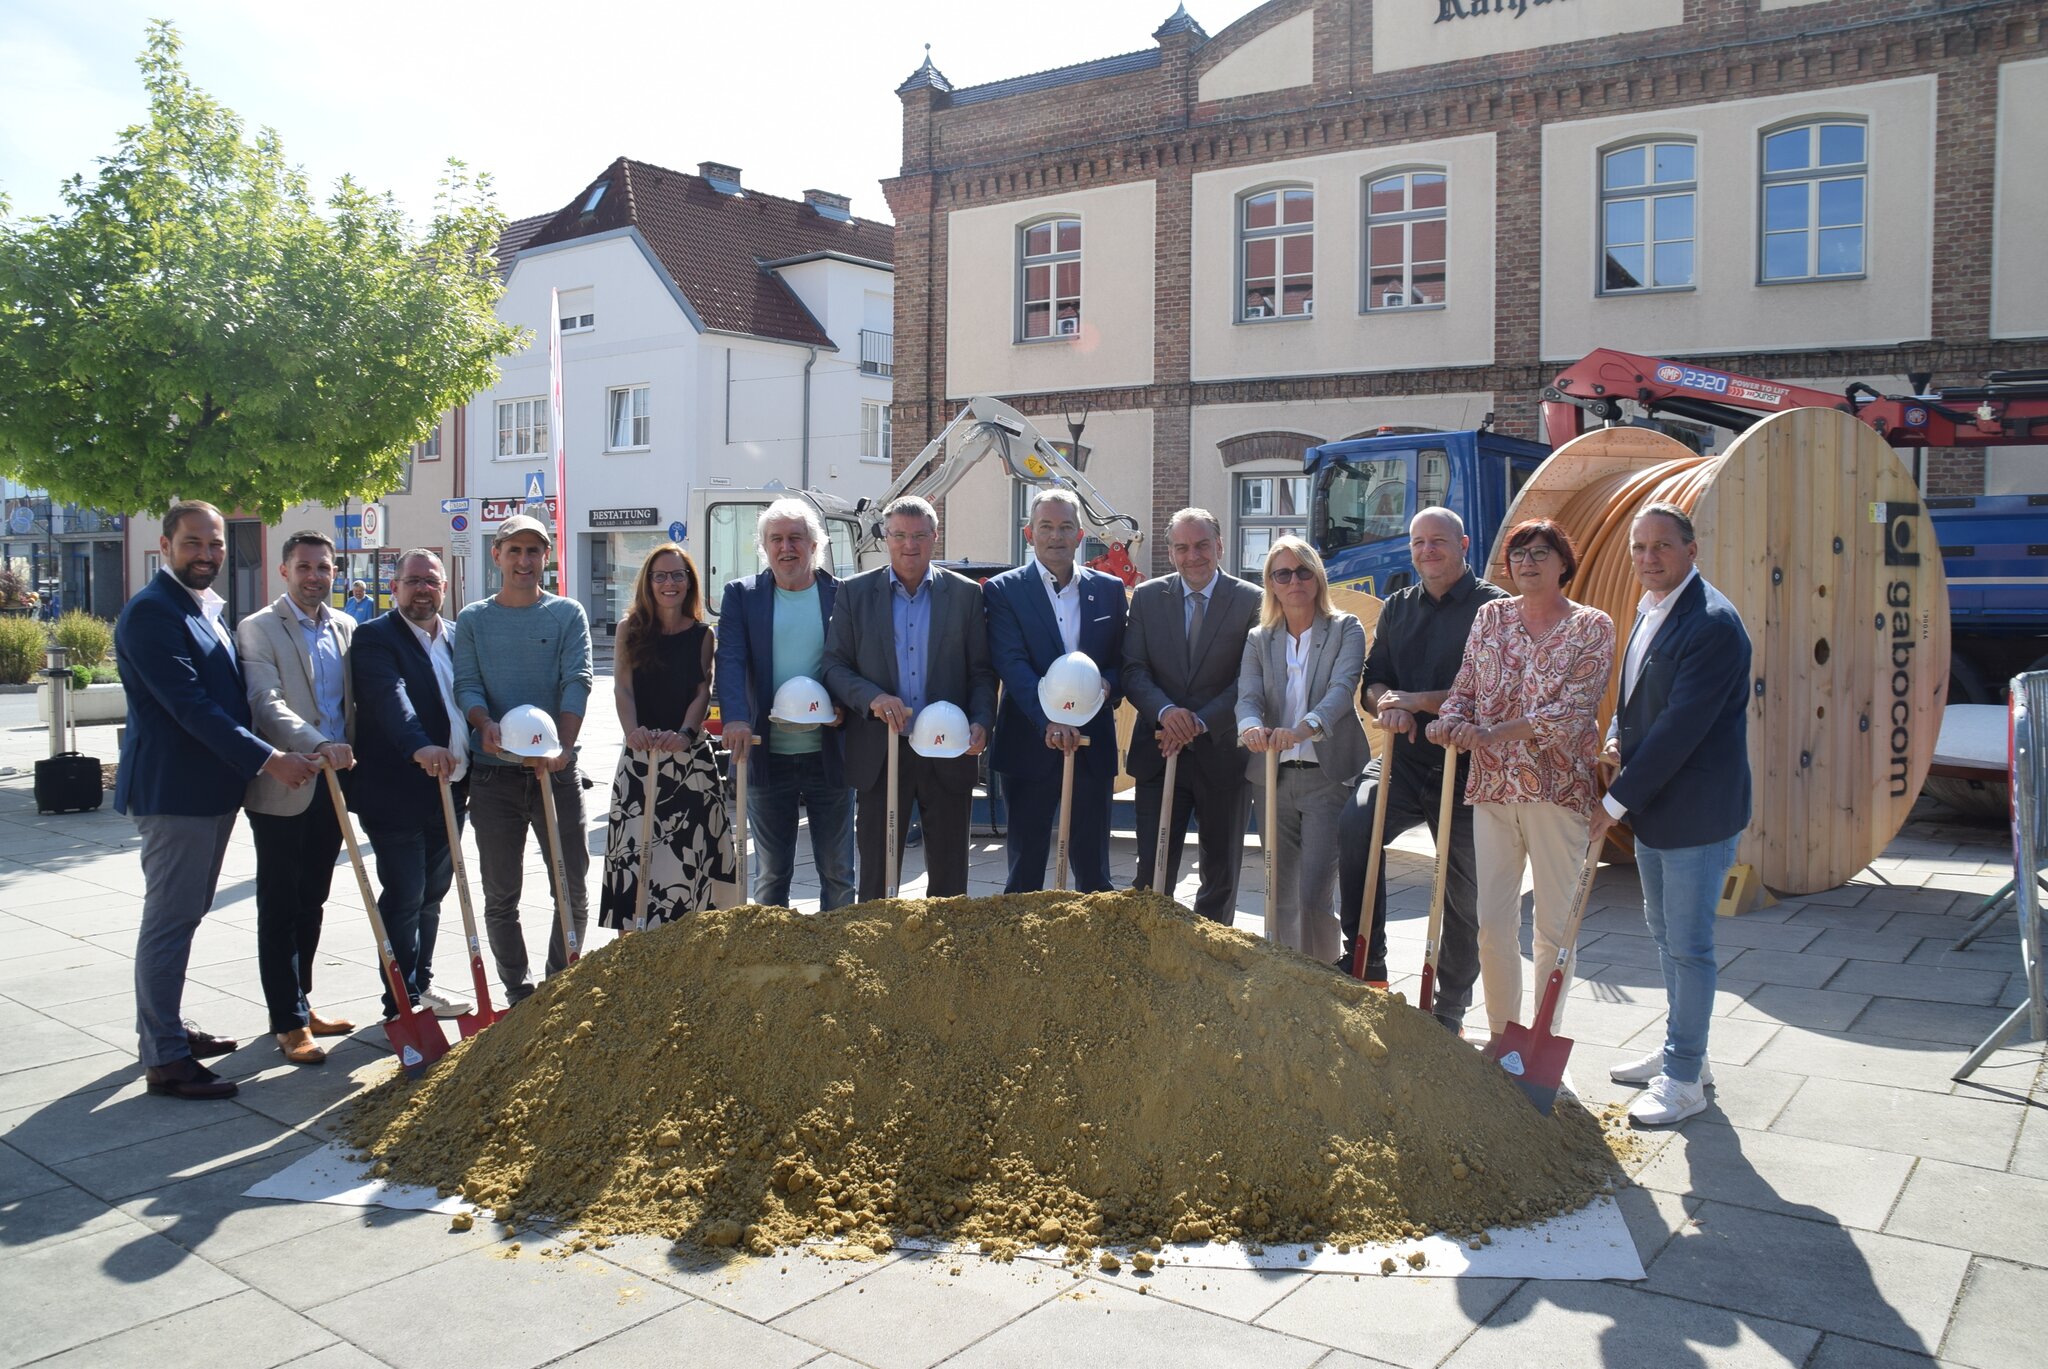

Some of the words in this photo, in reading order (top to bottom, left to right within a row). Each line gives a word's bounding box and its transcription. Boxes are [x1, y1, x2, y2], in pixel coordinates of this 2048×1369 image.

[1684, 371, 1728, 392] 2320
[1731, 379, 1761, 390] POWER
[1761, 383, 1772, 392] TO
[1773, 385, 1791, 396] LIFT
[592, 509, 651, 520] BESTATTUNG
[366, 514, 374, 528] 30
[364, 537, 376, 545] Zone
[1887, 580, 1915, 798] gabocom
[809, 701, 819, 712] A1
[1063, 701, 1075, 710] A1
[531, 733, 542, 745] A1
[934, 734, 945, 745] A1
